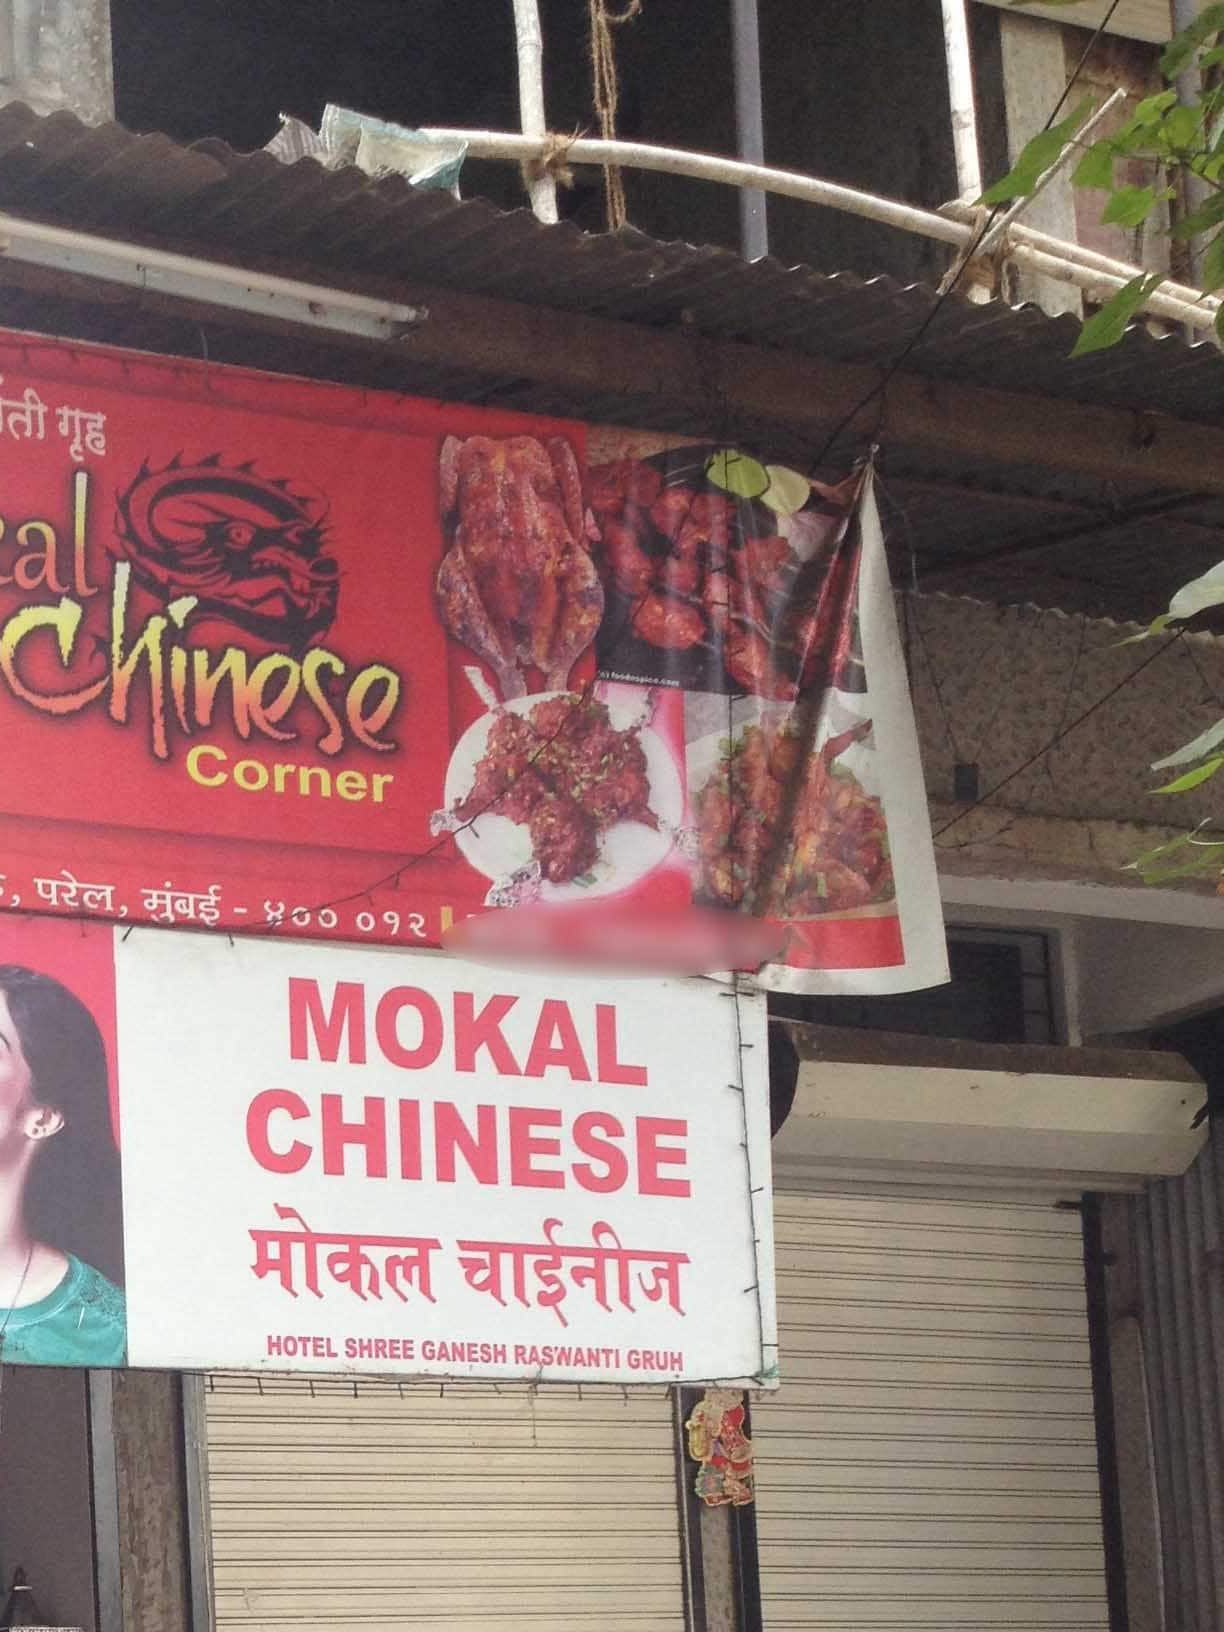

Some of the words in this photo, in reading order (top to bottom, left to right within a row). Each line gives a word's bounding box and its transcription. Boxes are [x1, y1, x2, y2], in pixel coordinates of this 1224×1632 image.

[56, 406, 106, 461] गृह
[0, 561, 400, 757] Chinese
[187, 745, 394, 803] Corner
[33, 870, 128, 917] परेल,
[141, 881, 221, 923] मुंबई
[265, 903, 337, 929] ४००
[356, 911, 427, 937] ०१२
[288, 977, 648, 1087] MOKAL
[246, 1089, 692, 1198] CHINESE
[248, 1202, 443, 1304] मोकल
[457, 1217, 692, 1328] चाईनीज
[267, 1335, 338, 1358] HOTEL
[345, 1338, 415, 1361] SHREE
[421, 1341, 507, 1364] GANESH
[515, 1345, 621, 1370] RASWANTI
[627, 1349, 683, 1372] GRUH
